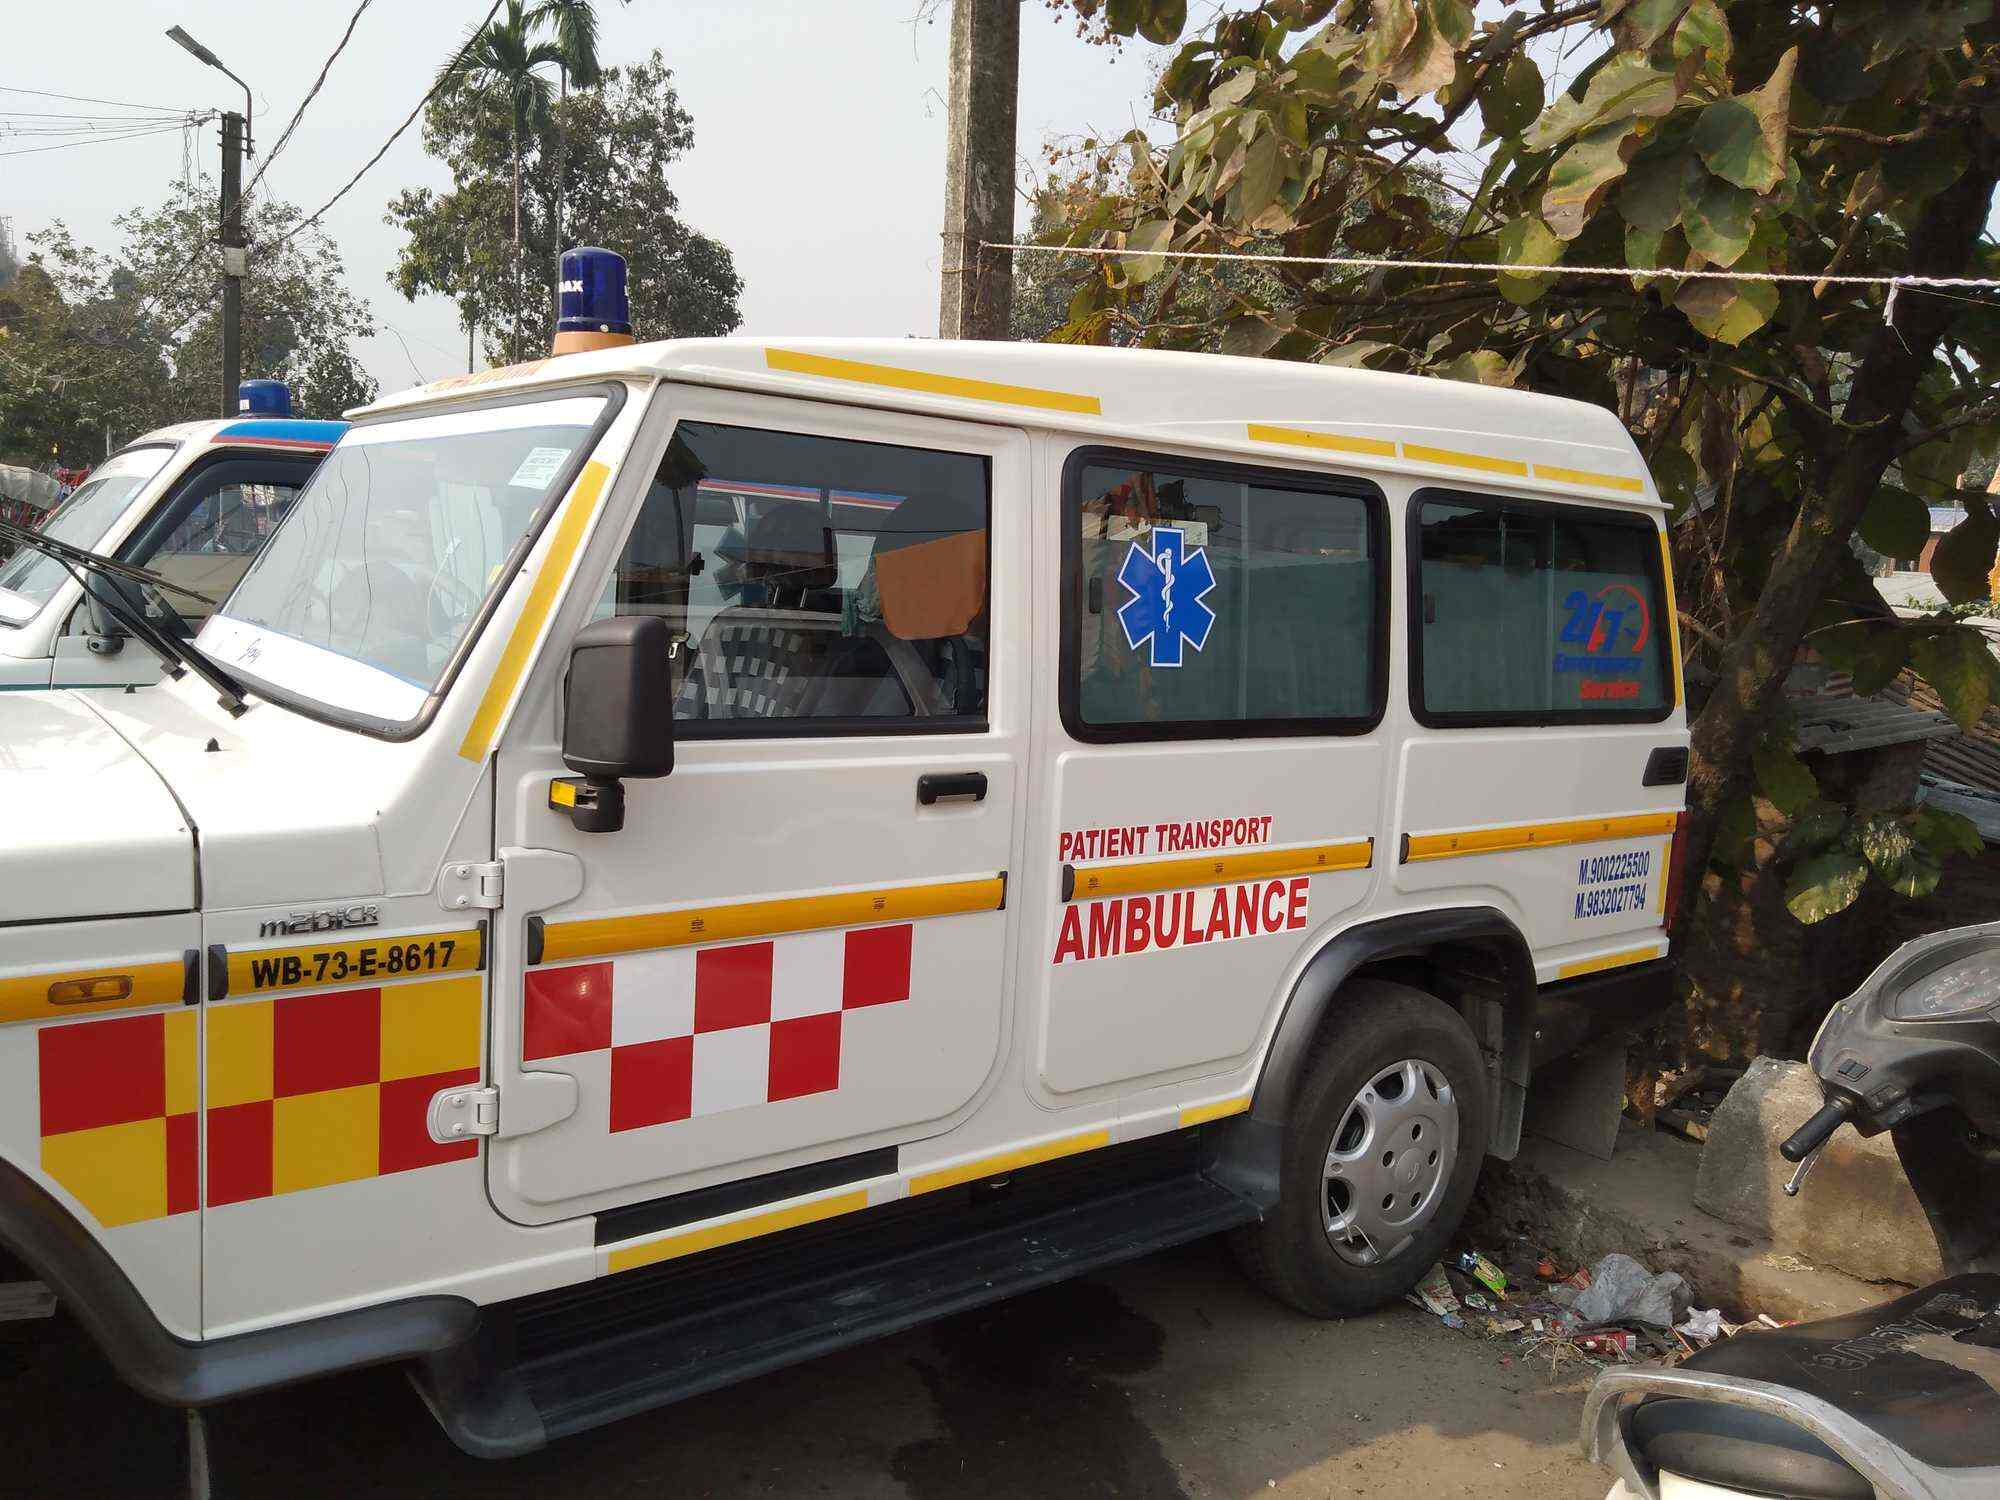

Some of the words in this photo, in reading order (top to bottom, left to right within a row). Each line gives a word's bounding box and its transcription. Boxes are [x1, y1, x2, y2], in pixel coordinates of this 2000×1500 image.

[1059, 826, 1149, 861] PATIENT
[1156, 816, 1272, 853] TRANSPORT
[1578, 850, 1650, 885] M.9002225500
[1053, 877, 1310, 964] AMBULANCE
[1575, 883, 1647, 919] M.9832027794
[251, 940, 456, 988] WB-73-E-8617
